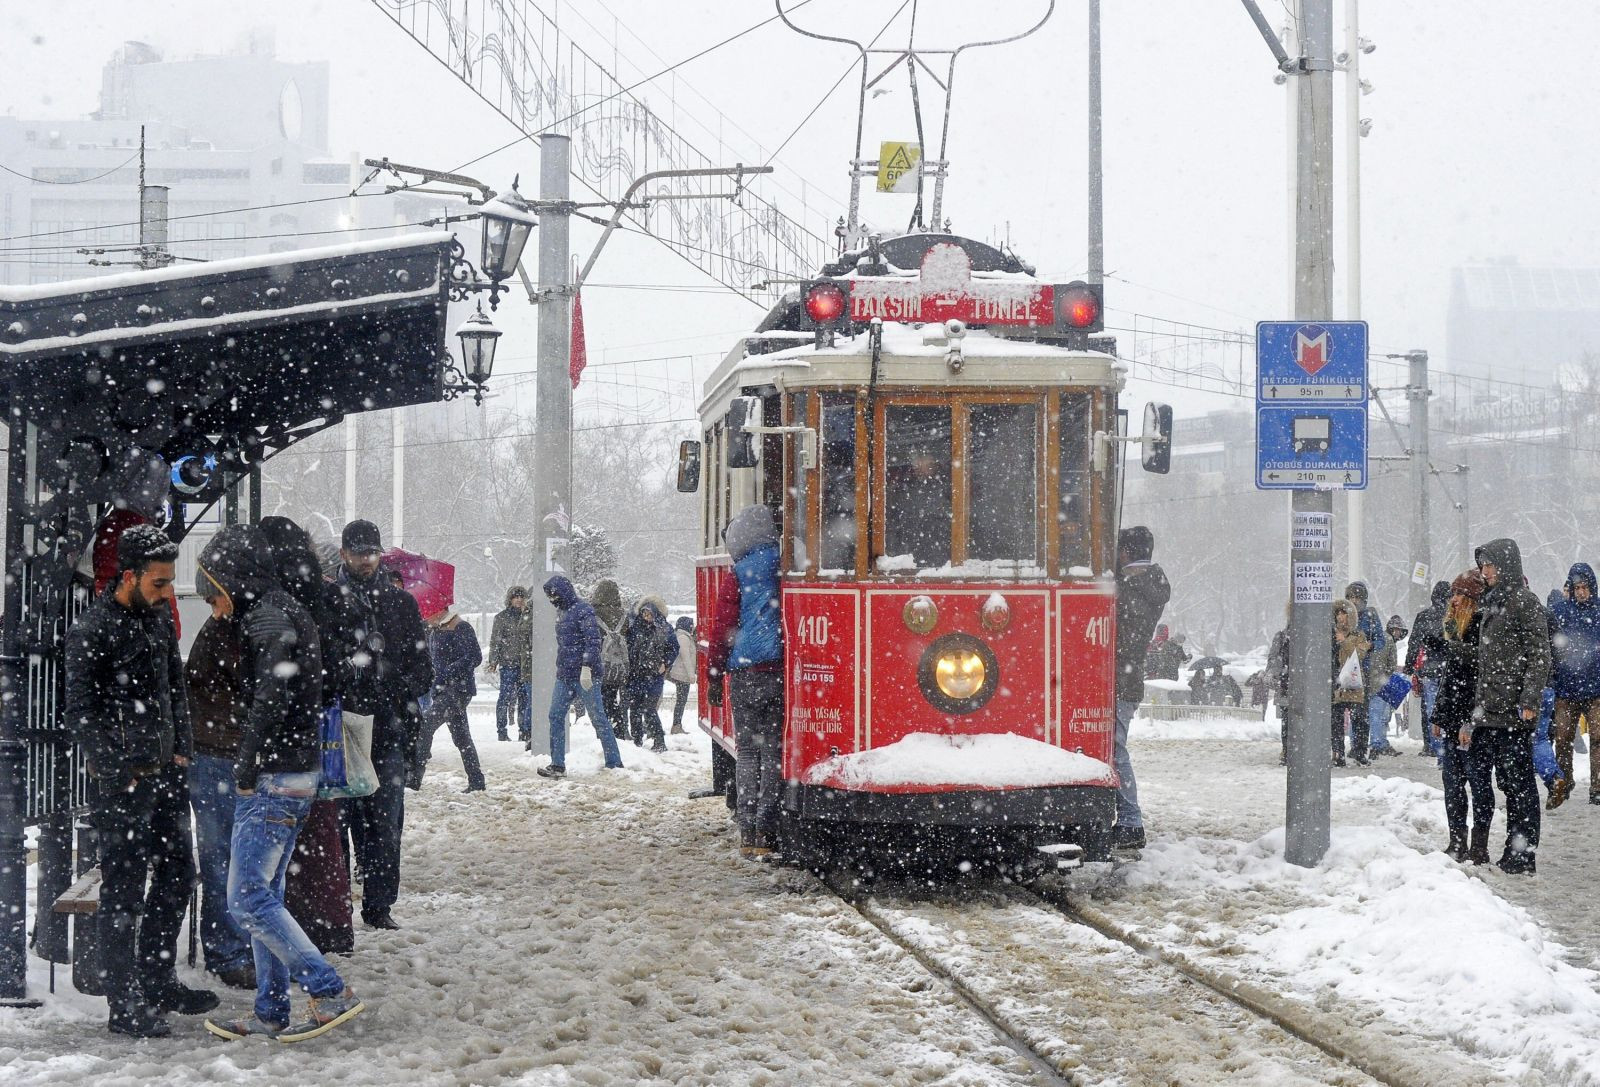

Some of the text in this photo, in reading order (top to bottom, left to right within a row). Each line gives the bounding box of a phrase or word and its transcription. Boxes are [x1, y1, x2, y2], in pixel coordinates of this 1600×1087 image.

[1265, 460, 1303, 469] OTOBÜS
[1297, 472, 1314, 481] 210
[1296, 565, 1333, 573] GÜNLÜ
[798, 616, 828, 645] 410
[1086, 616, 1110, 647] 410
[803, 672, 818, 682] ALO
